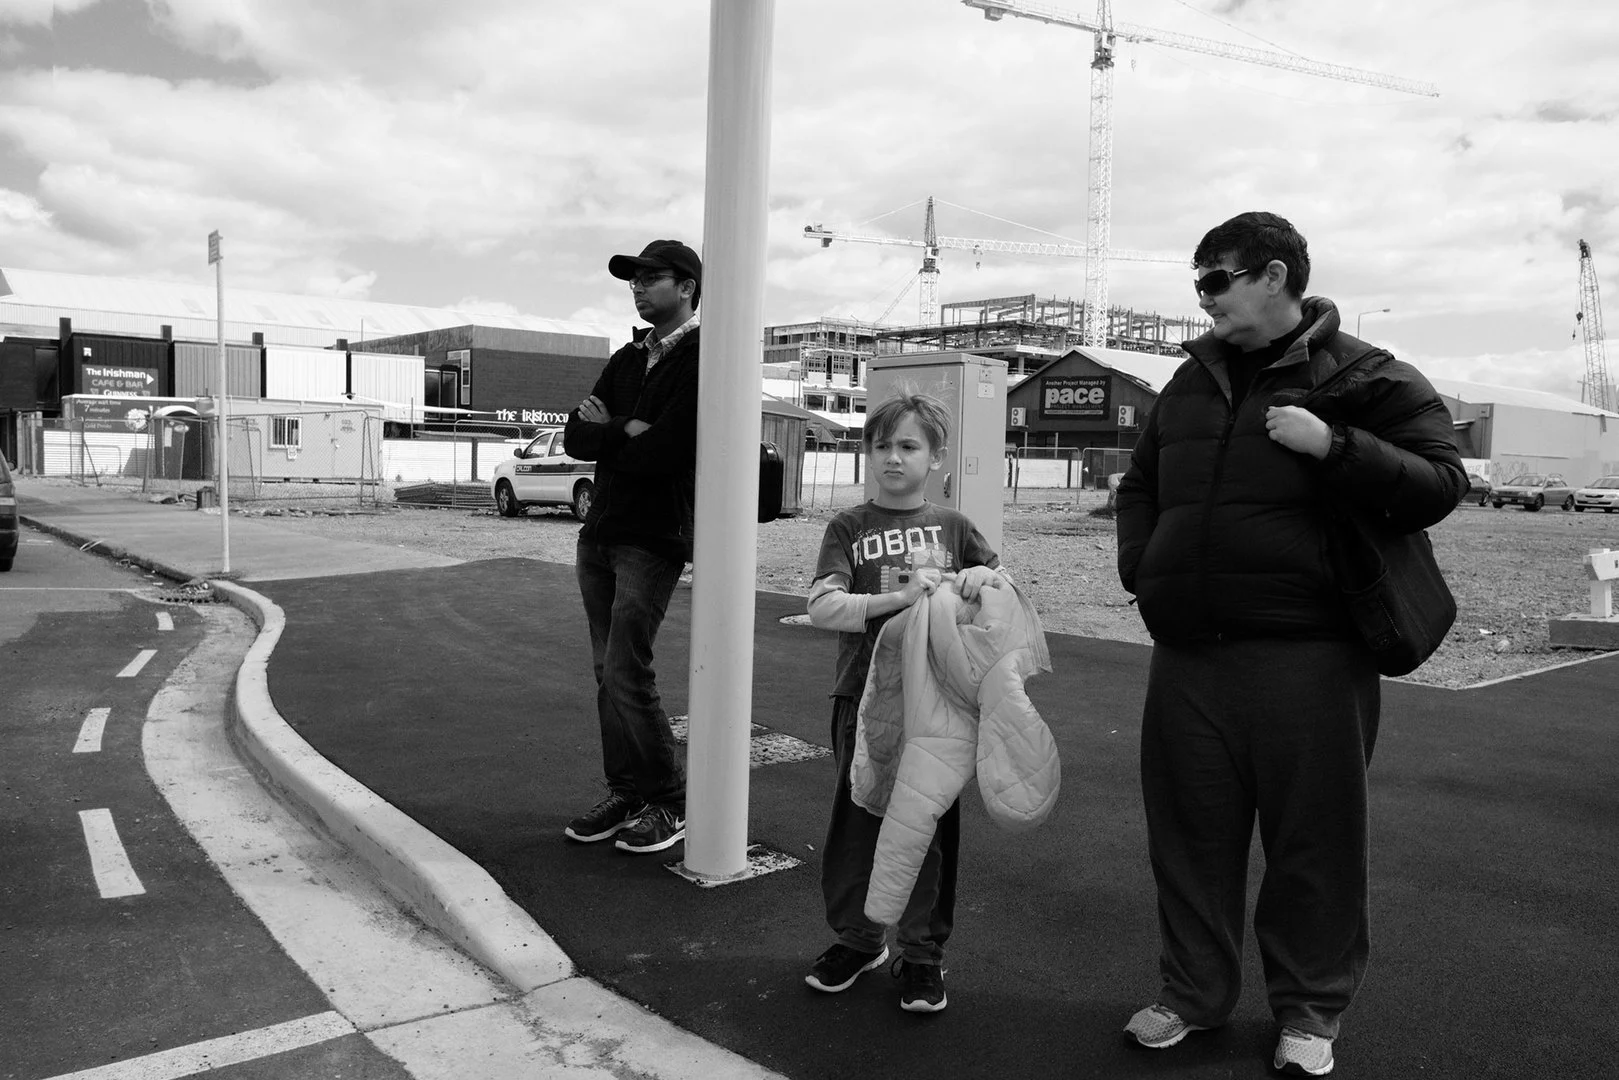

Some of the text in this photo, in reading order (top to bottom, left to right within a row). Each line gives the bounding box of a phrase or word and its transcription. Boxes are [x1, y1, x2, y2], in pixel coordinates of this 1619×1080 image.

[86, 367, 146, 379] The Irishman
[92, 379, 144, 389] CAFE & BAR
[1045, 387, 1105, 409] pace
[84, 404, 90, 412] 7
